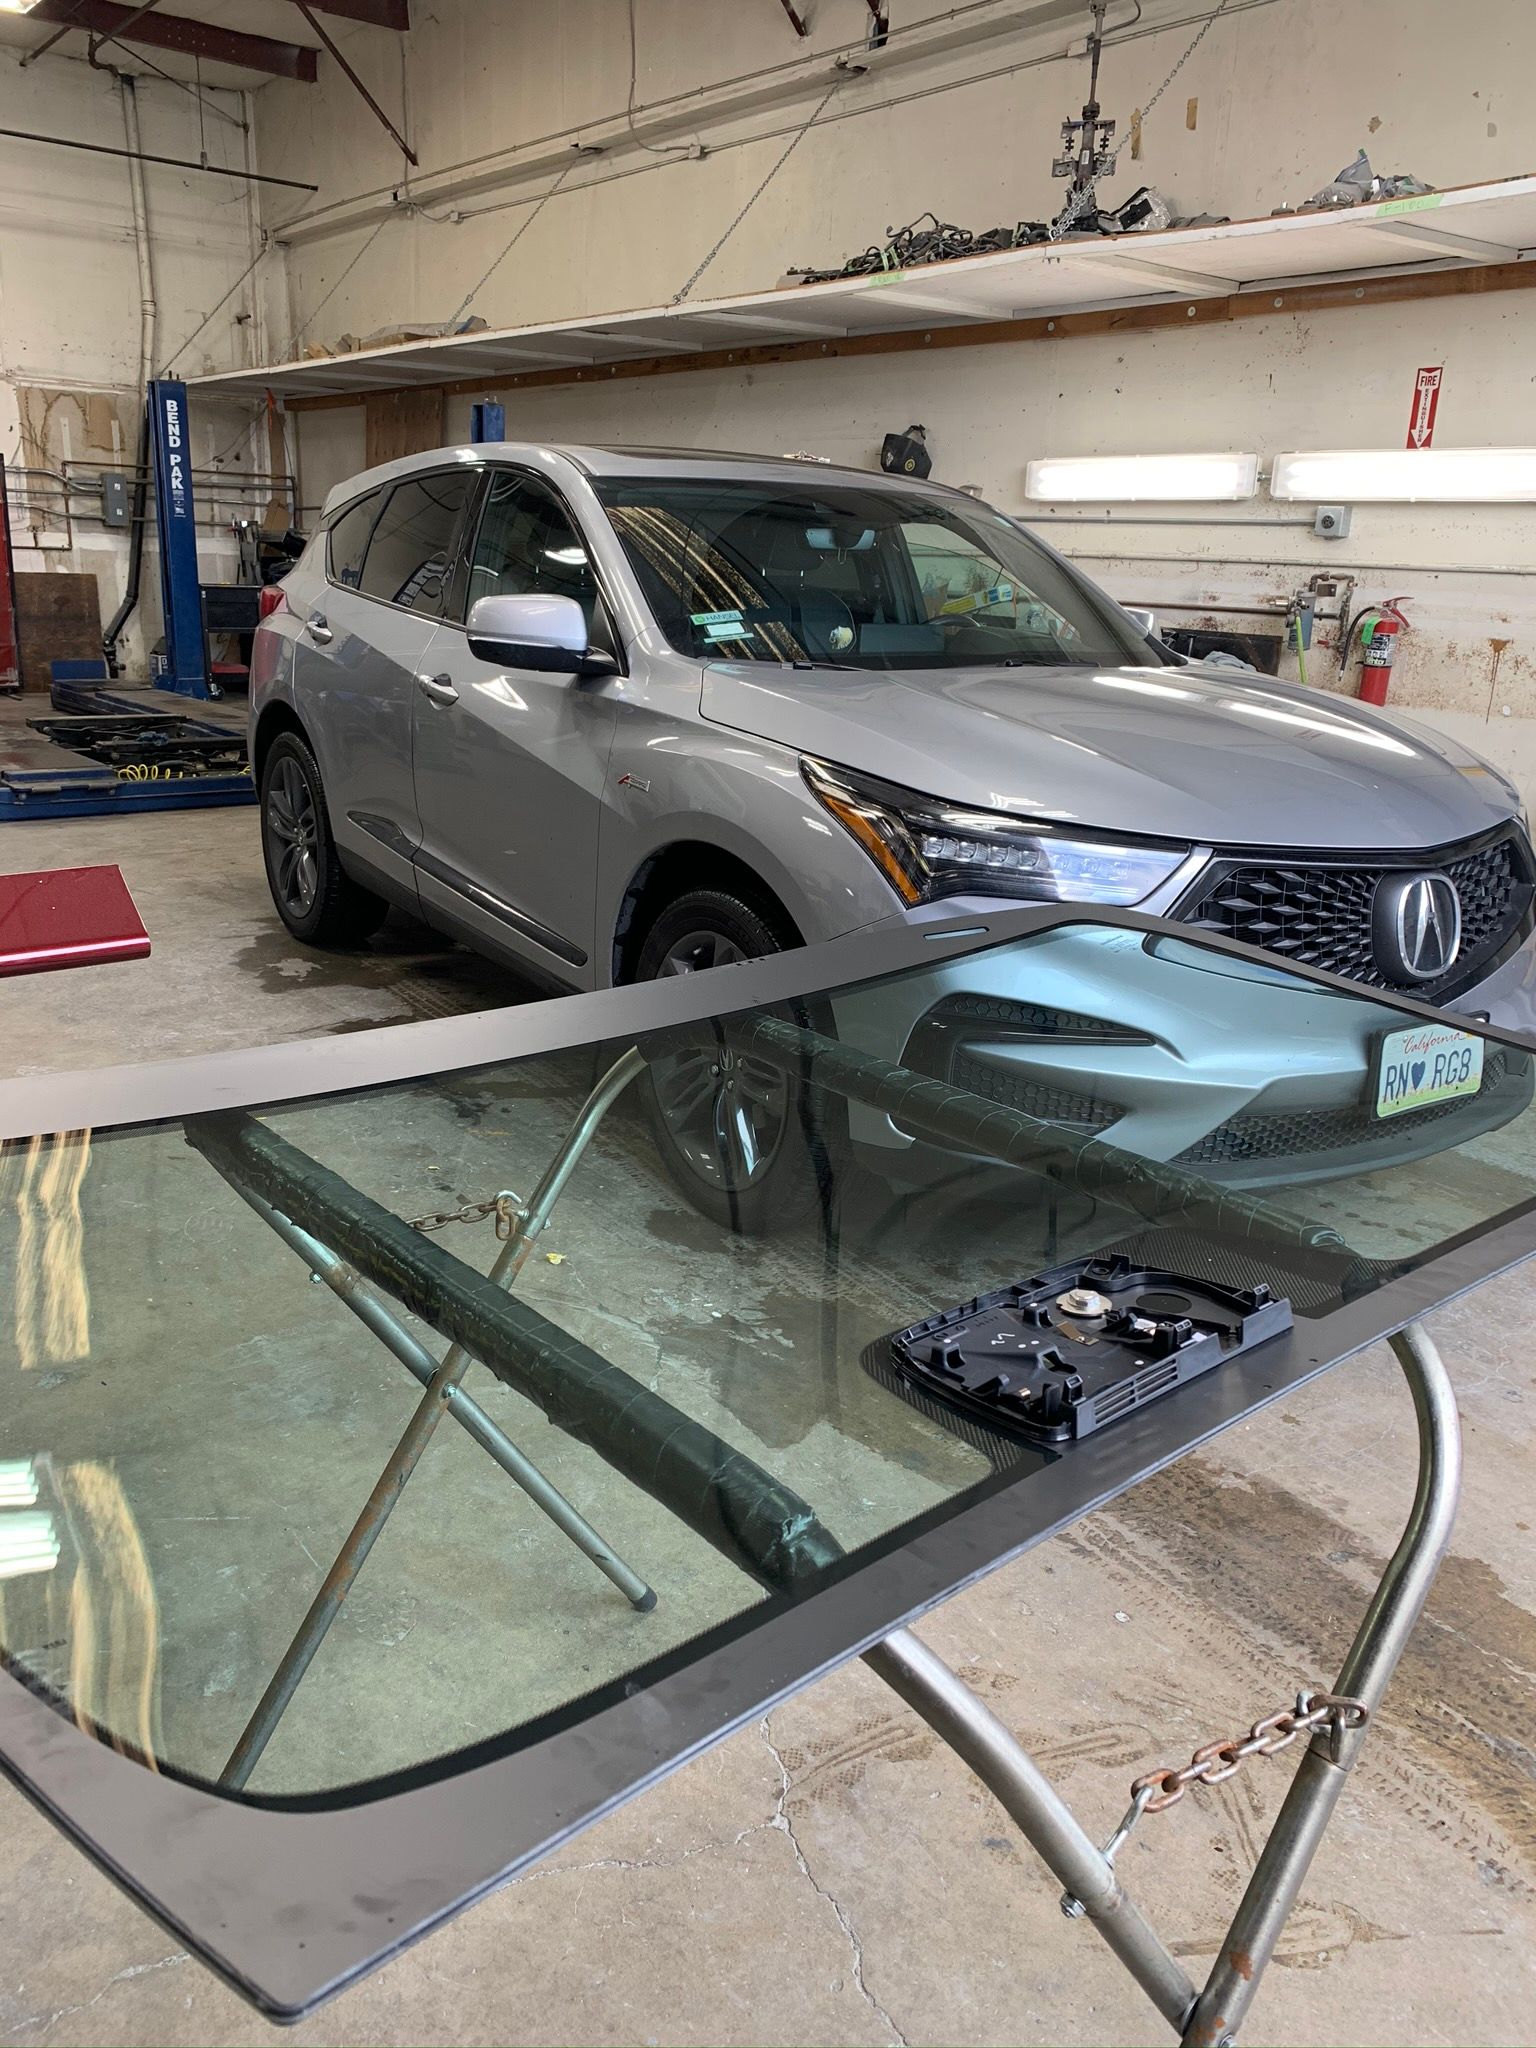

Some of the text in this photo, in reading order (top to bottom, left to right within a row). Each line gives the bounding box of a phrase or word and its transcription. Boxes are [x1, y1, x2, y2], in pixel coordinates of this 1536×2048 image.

[1420, 375, 1437, 386] FIRE
[166, 400, 181, 448] BEND
[1417, 388, 1429, 442] EXTINGUISHER
[170, 454, 184, 490] PAK
[1404, 1031, 1465, 1054] California
[1431, 1047, 1472, 1090] RG8
